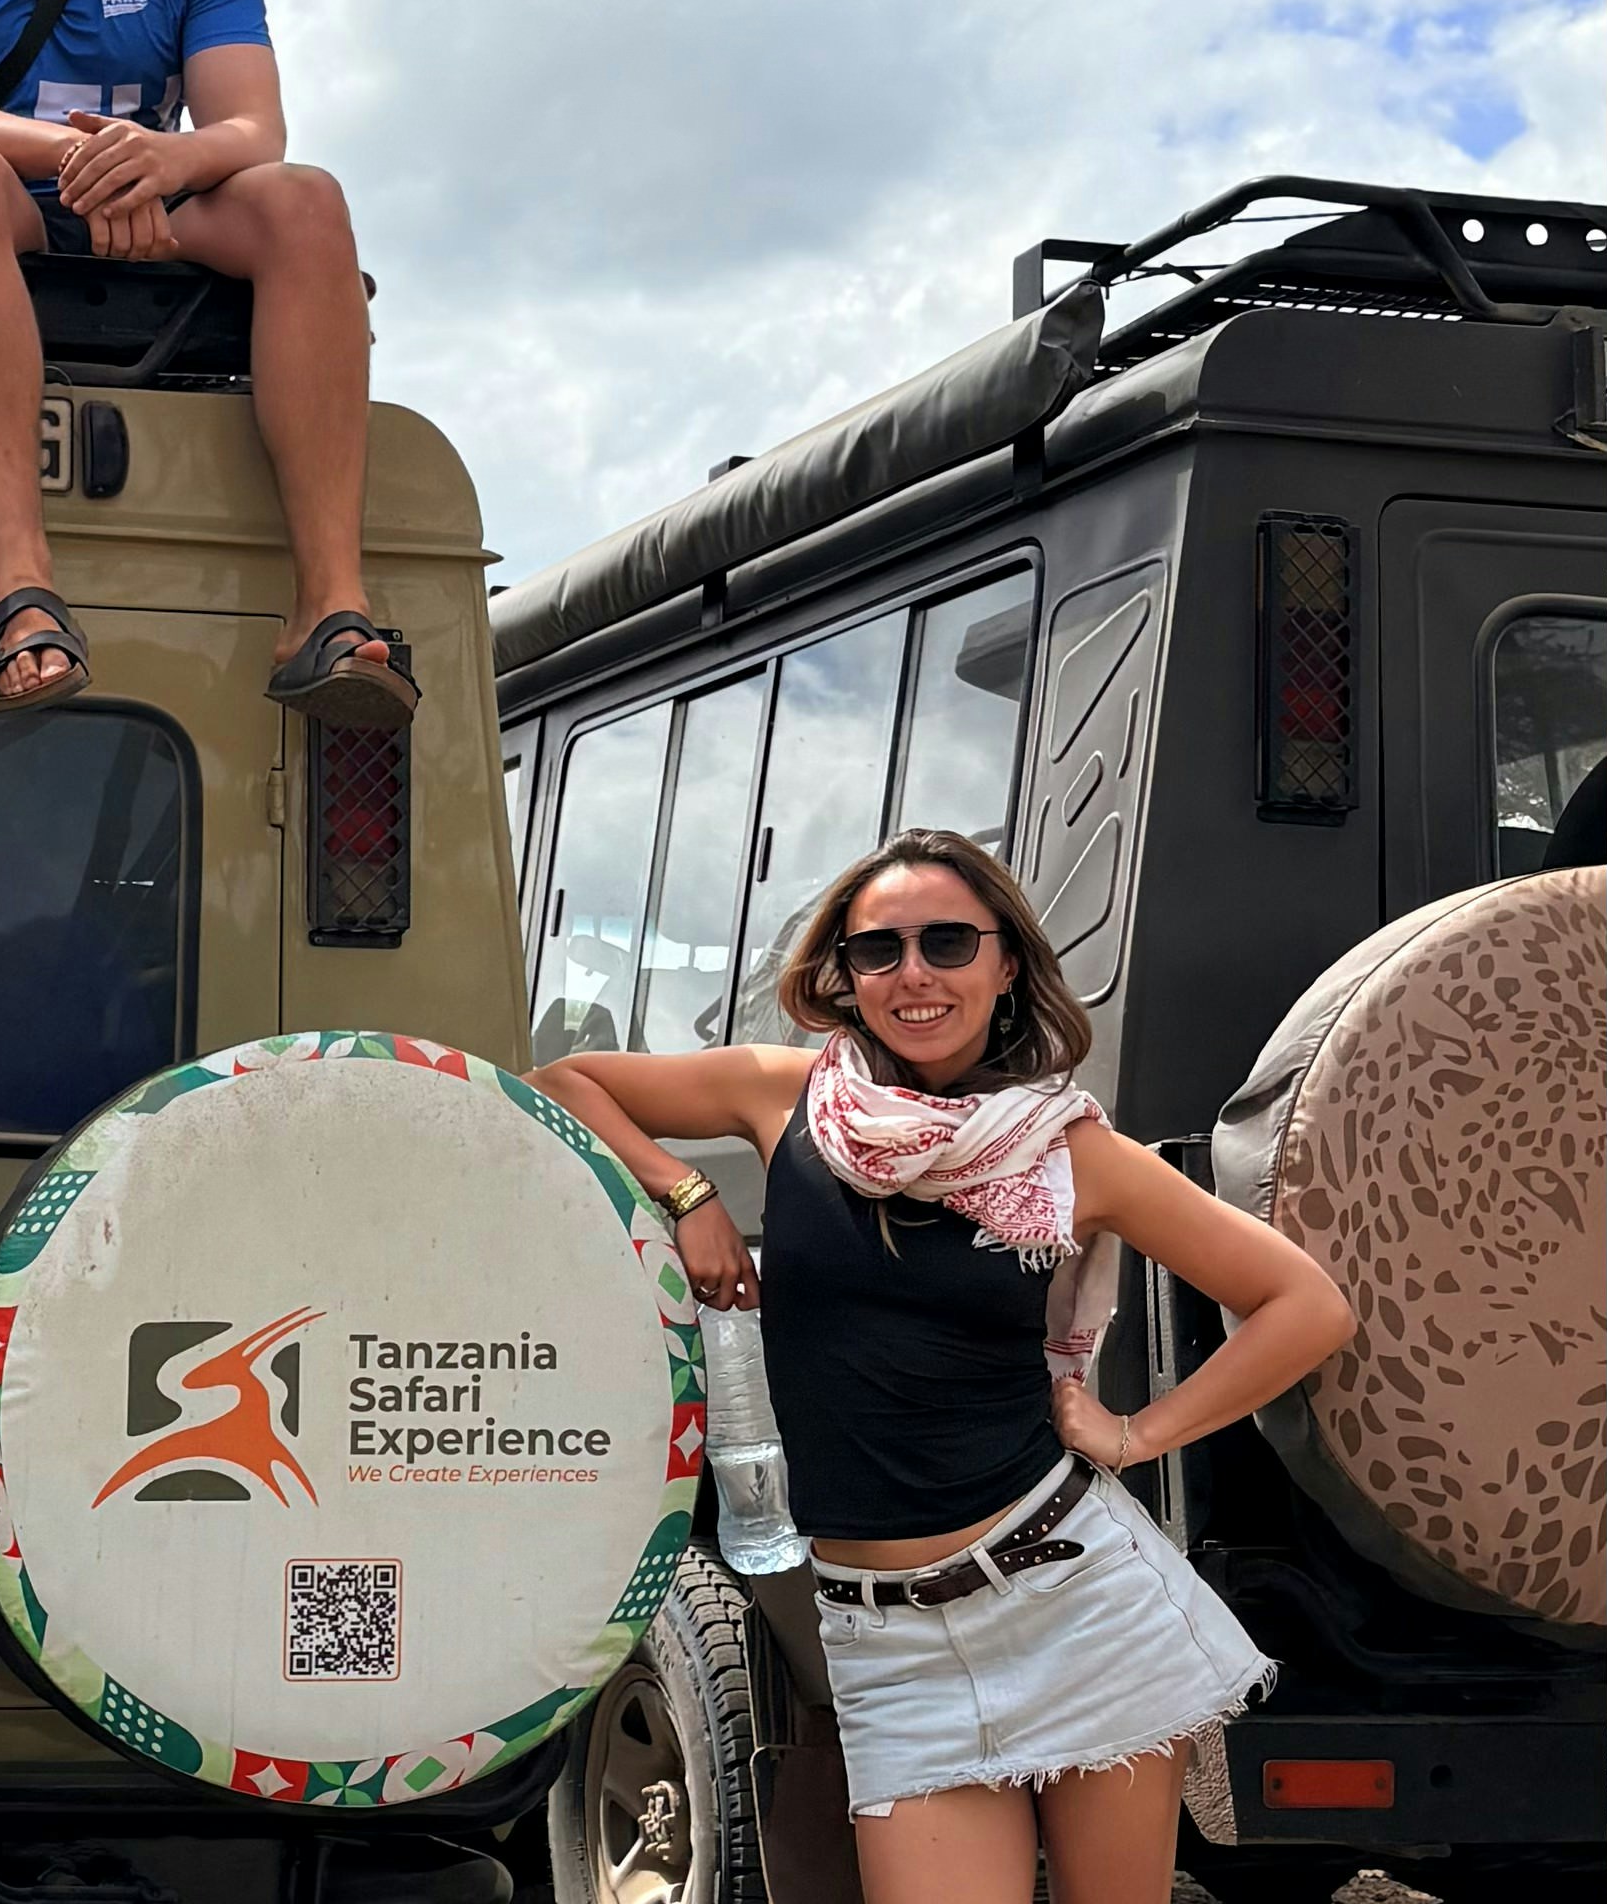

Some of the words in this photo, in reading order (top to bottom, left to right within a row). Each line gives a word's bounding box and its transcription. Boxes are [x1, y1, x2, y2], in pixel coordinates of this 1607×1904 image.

[349, 1331, 558, 1371] Tanzania
[349, 1373, 482, 1414] Safari
[349, 1417, 612, 1465] Experience
[348, 1464, 383, 1483] We
[388, 1464, 462, 1483] Create
[467, 1464, 600, 1487] Experiences
